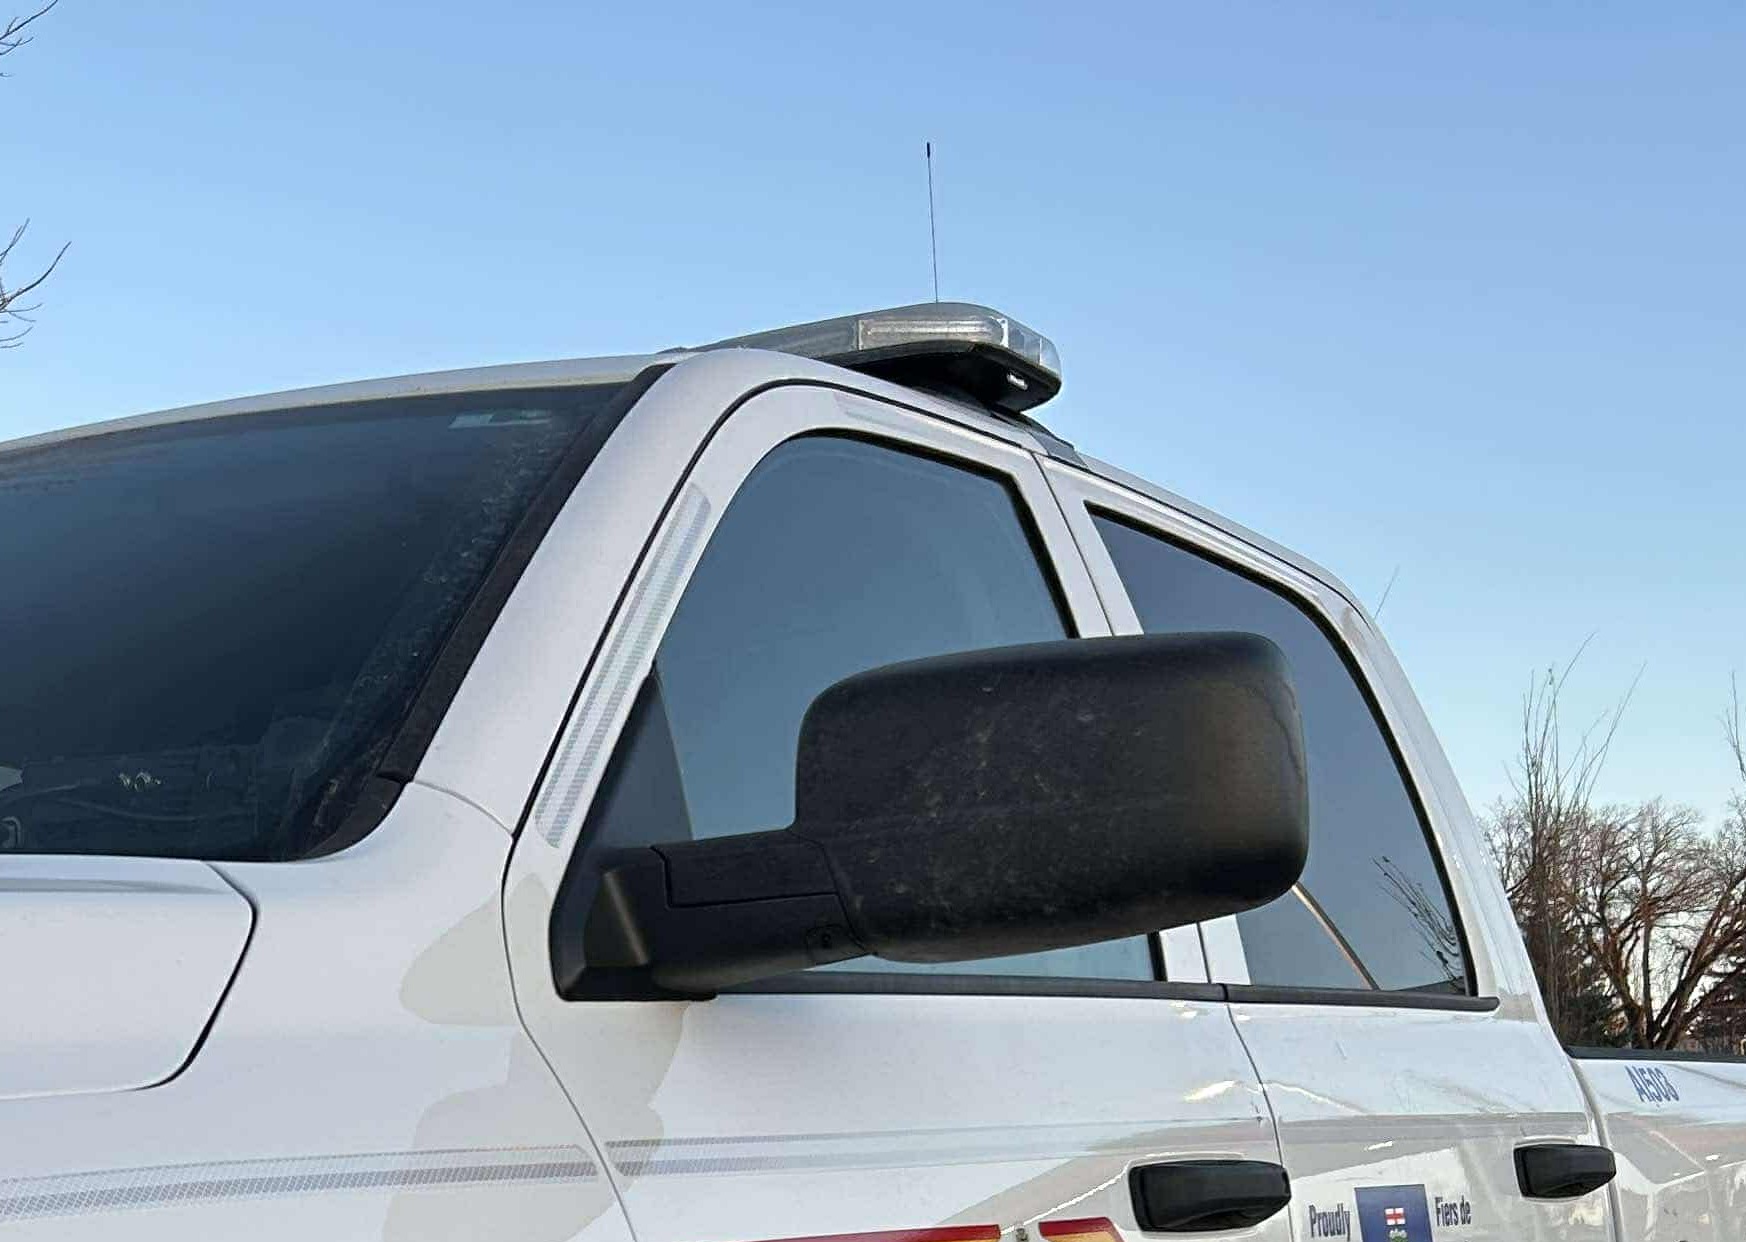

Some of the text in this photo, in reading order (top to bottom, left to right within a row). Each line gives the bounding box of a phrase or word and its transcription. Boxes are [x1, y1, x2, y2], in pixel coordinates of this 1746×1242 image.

[1309, 1203, 1351, 1242] Proudly
[1435, 1195, 1471, 1226] Fiers de
